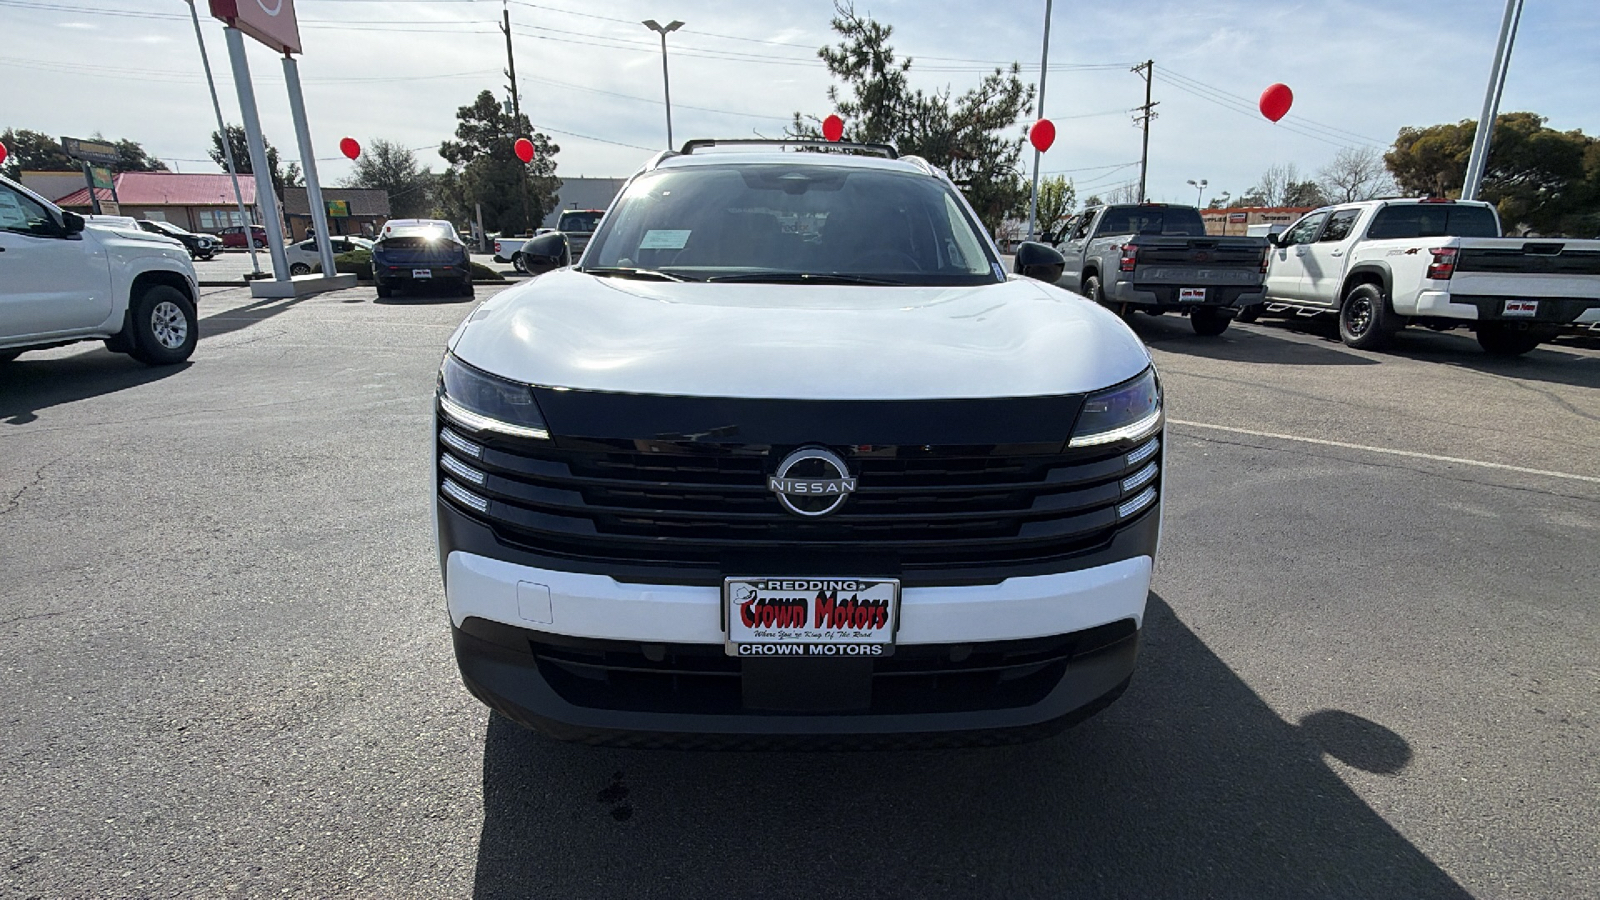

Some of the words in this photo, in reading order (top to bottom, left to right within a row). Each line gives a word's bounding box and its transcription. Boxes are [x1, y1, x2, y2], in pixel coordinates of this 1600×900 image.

[771, 479, 854, 493] NISSAN
[768, 581, 858, 591] REDDING
[740, 594, 808, 629] Crown
[814, 591, 889, 630] Motors
[753, 630, 776, 638] Where
[777, 630, 802, 640] You're
[804, 631, 822, 639] King
[824, 631, 835, 640] Of
[739, 644, 804, 655] CROWN
[809, 644, 883, 656] MOTORS
